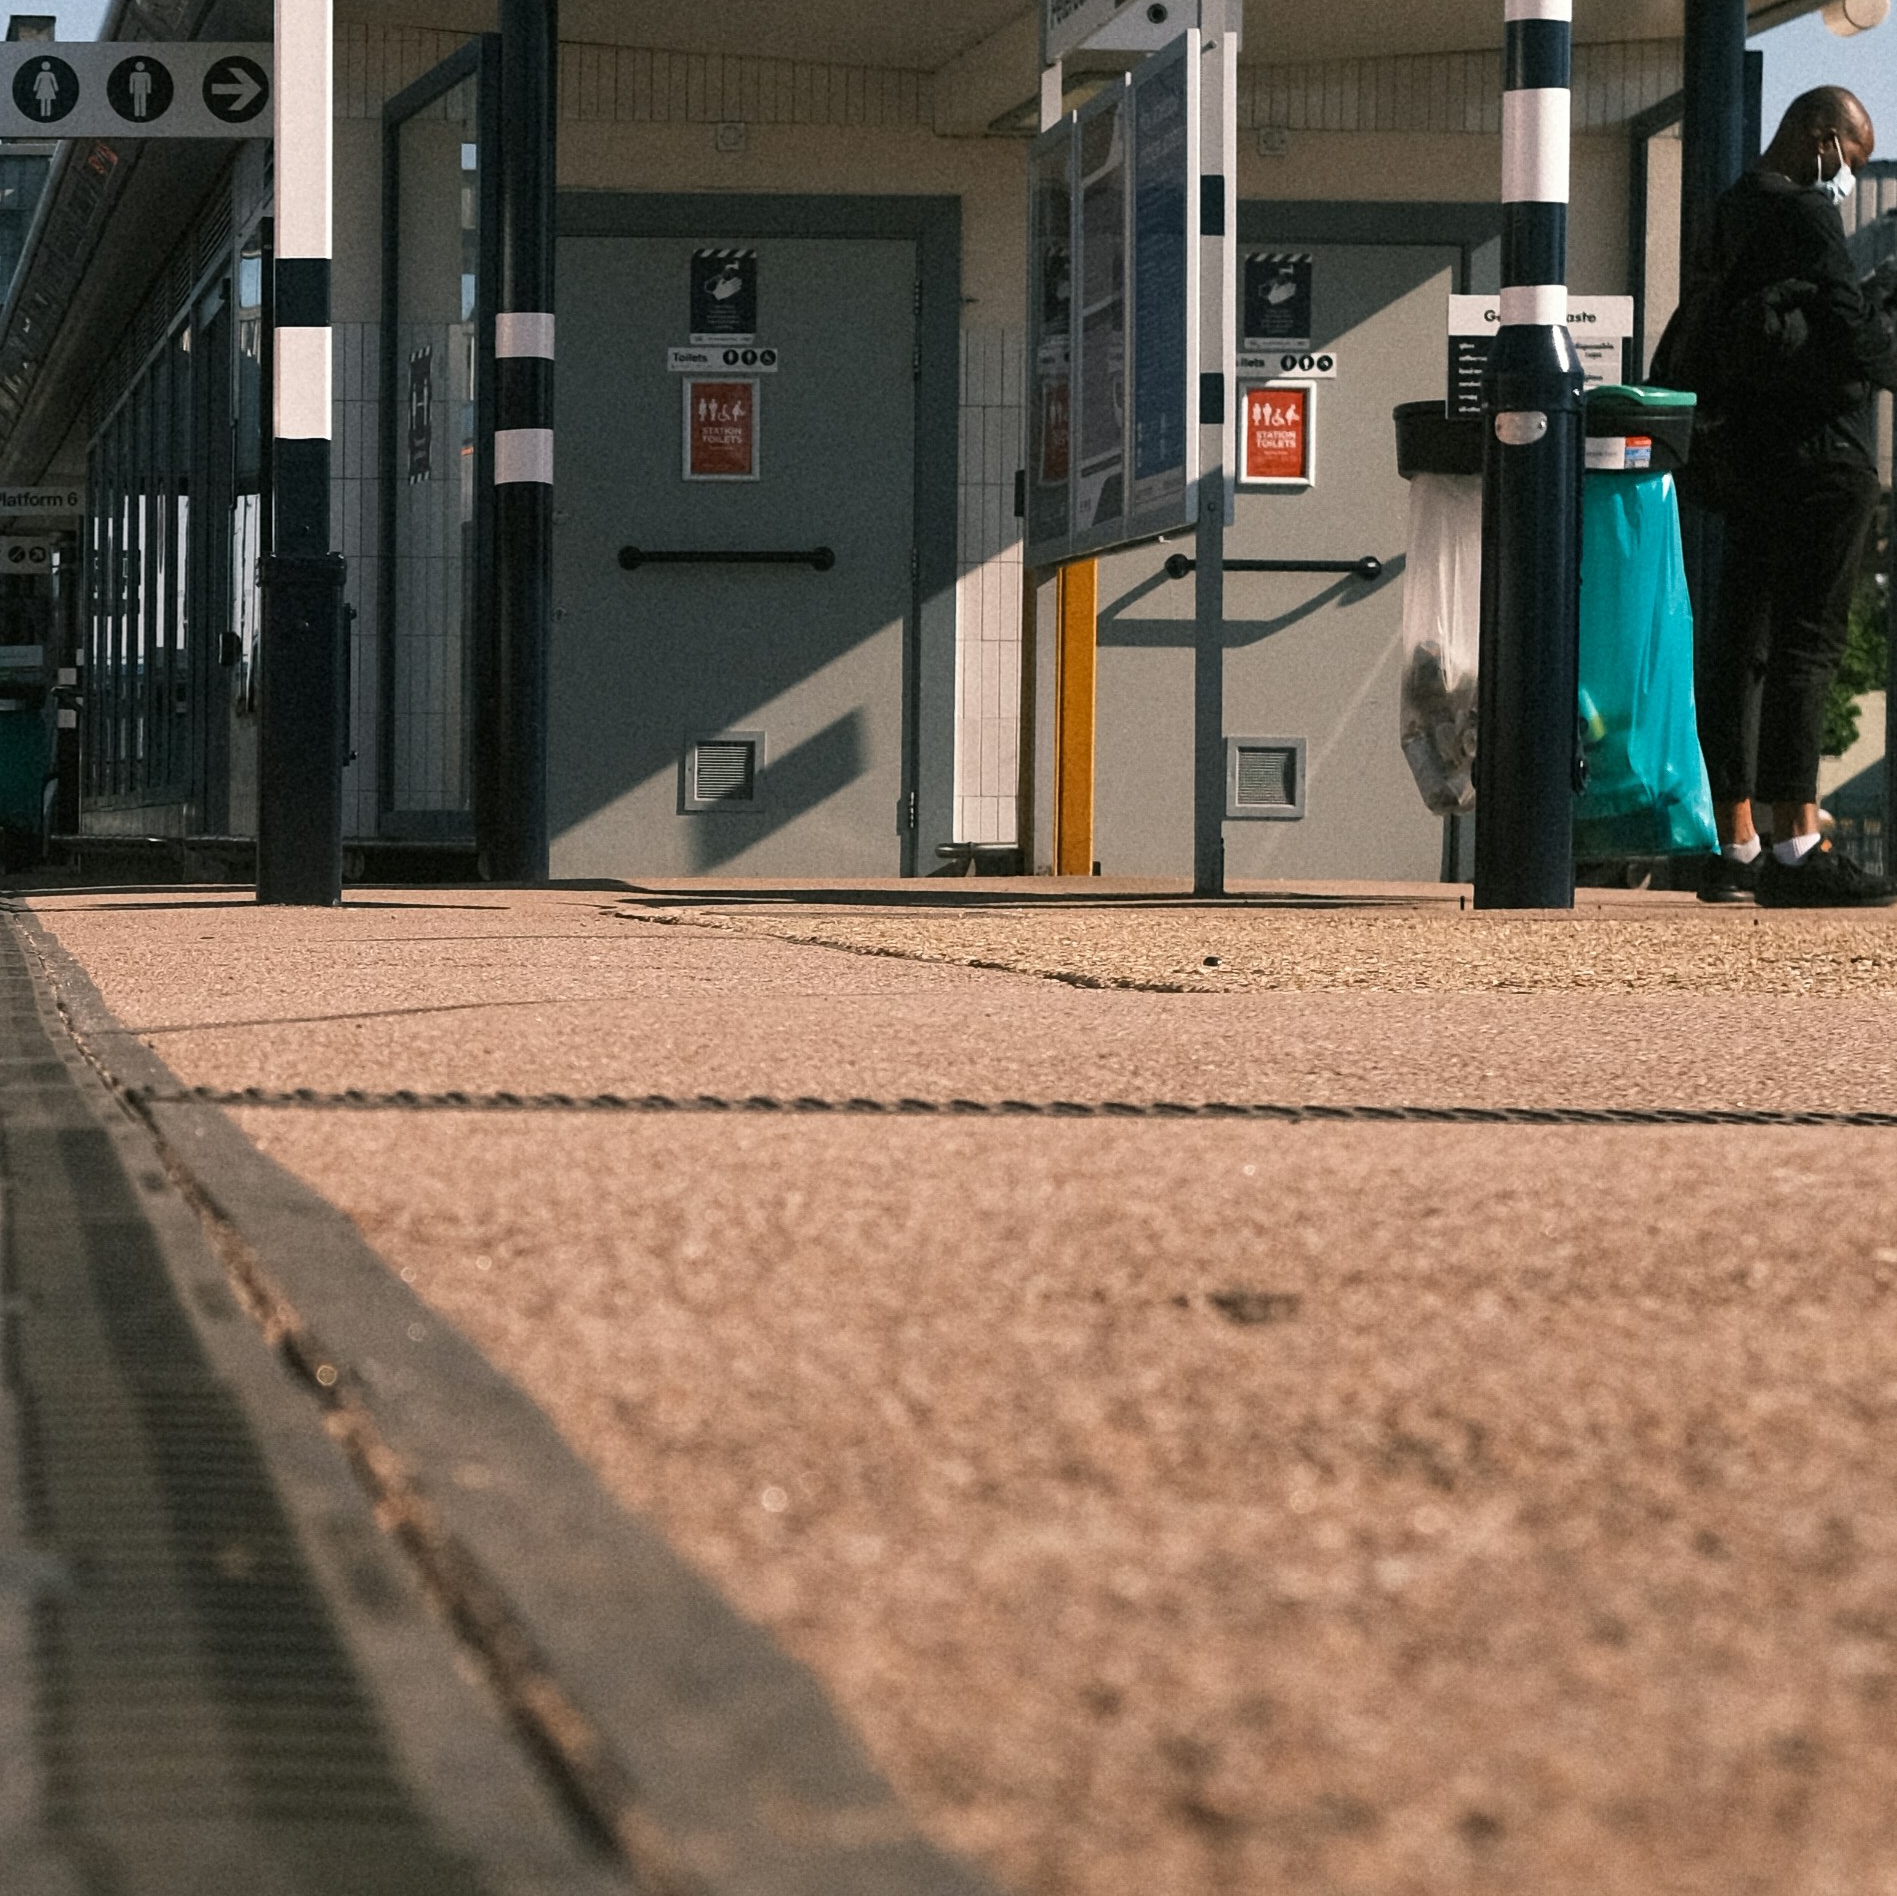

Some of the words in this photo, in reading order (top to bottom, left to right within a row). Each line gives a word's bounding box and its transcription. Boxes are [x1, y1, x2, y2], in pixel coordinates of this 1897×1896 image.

[1566, 311, 1597, 323] aste
[672, 352, 708, 363] Toilets
[702, 426, 742, 435] STATION
[1256, 430, 1297, 439] STATION
[702, 435, 743, 444] TOILETS
[1256, 439, 1297, 448] TOILETS
[67, 492, 78, 507] 6
